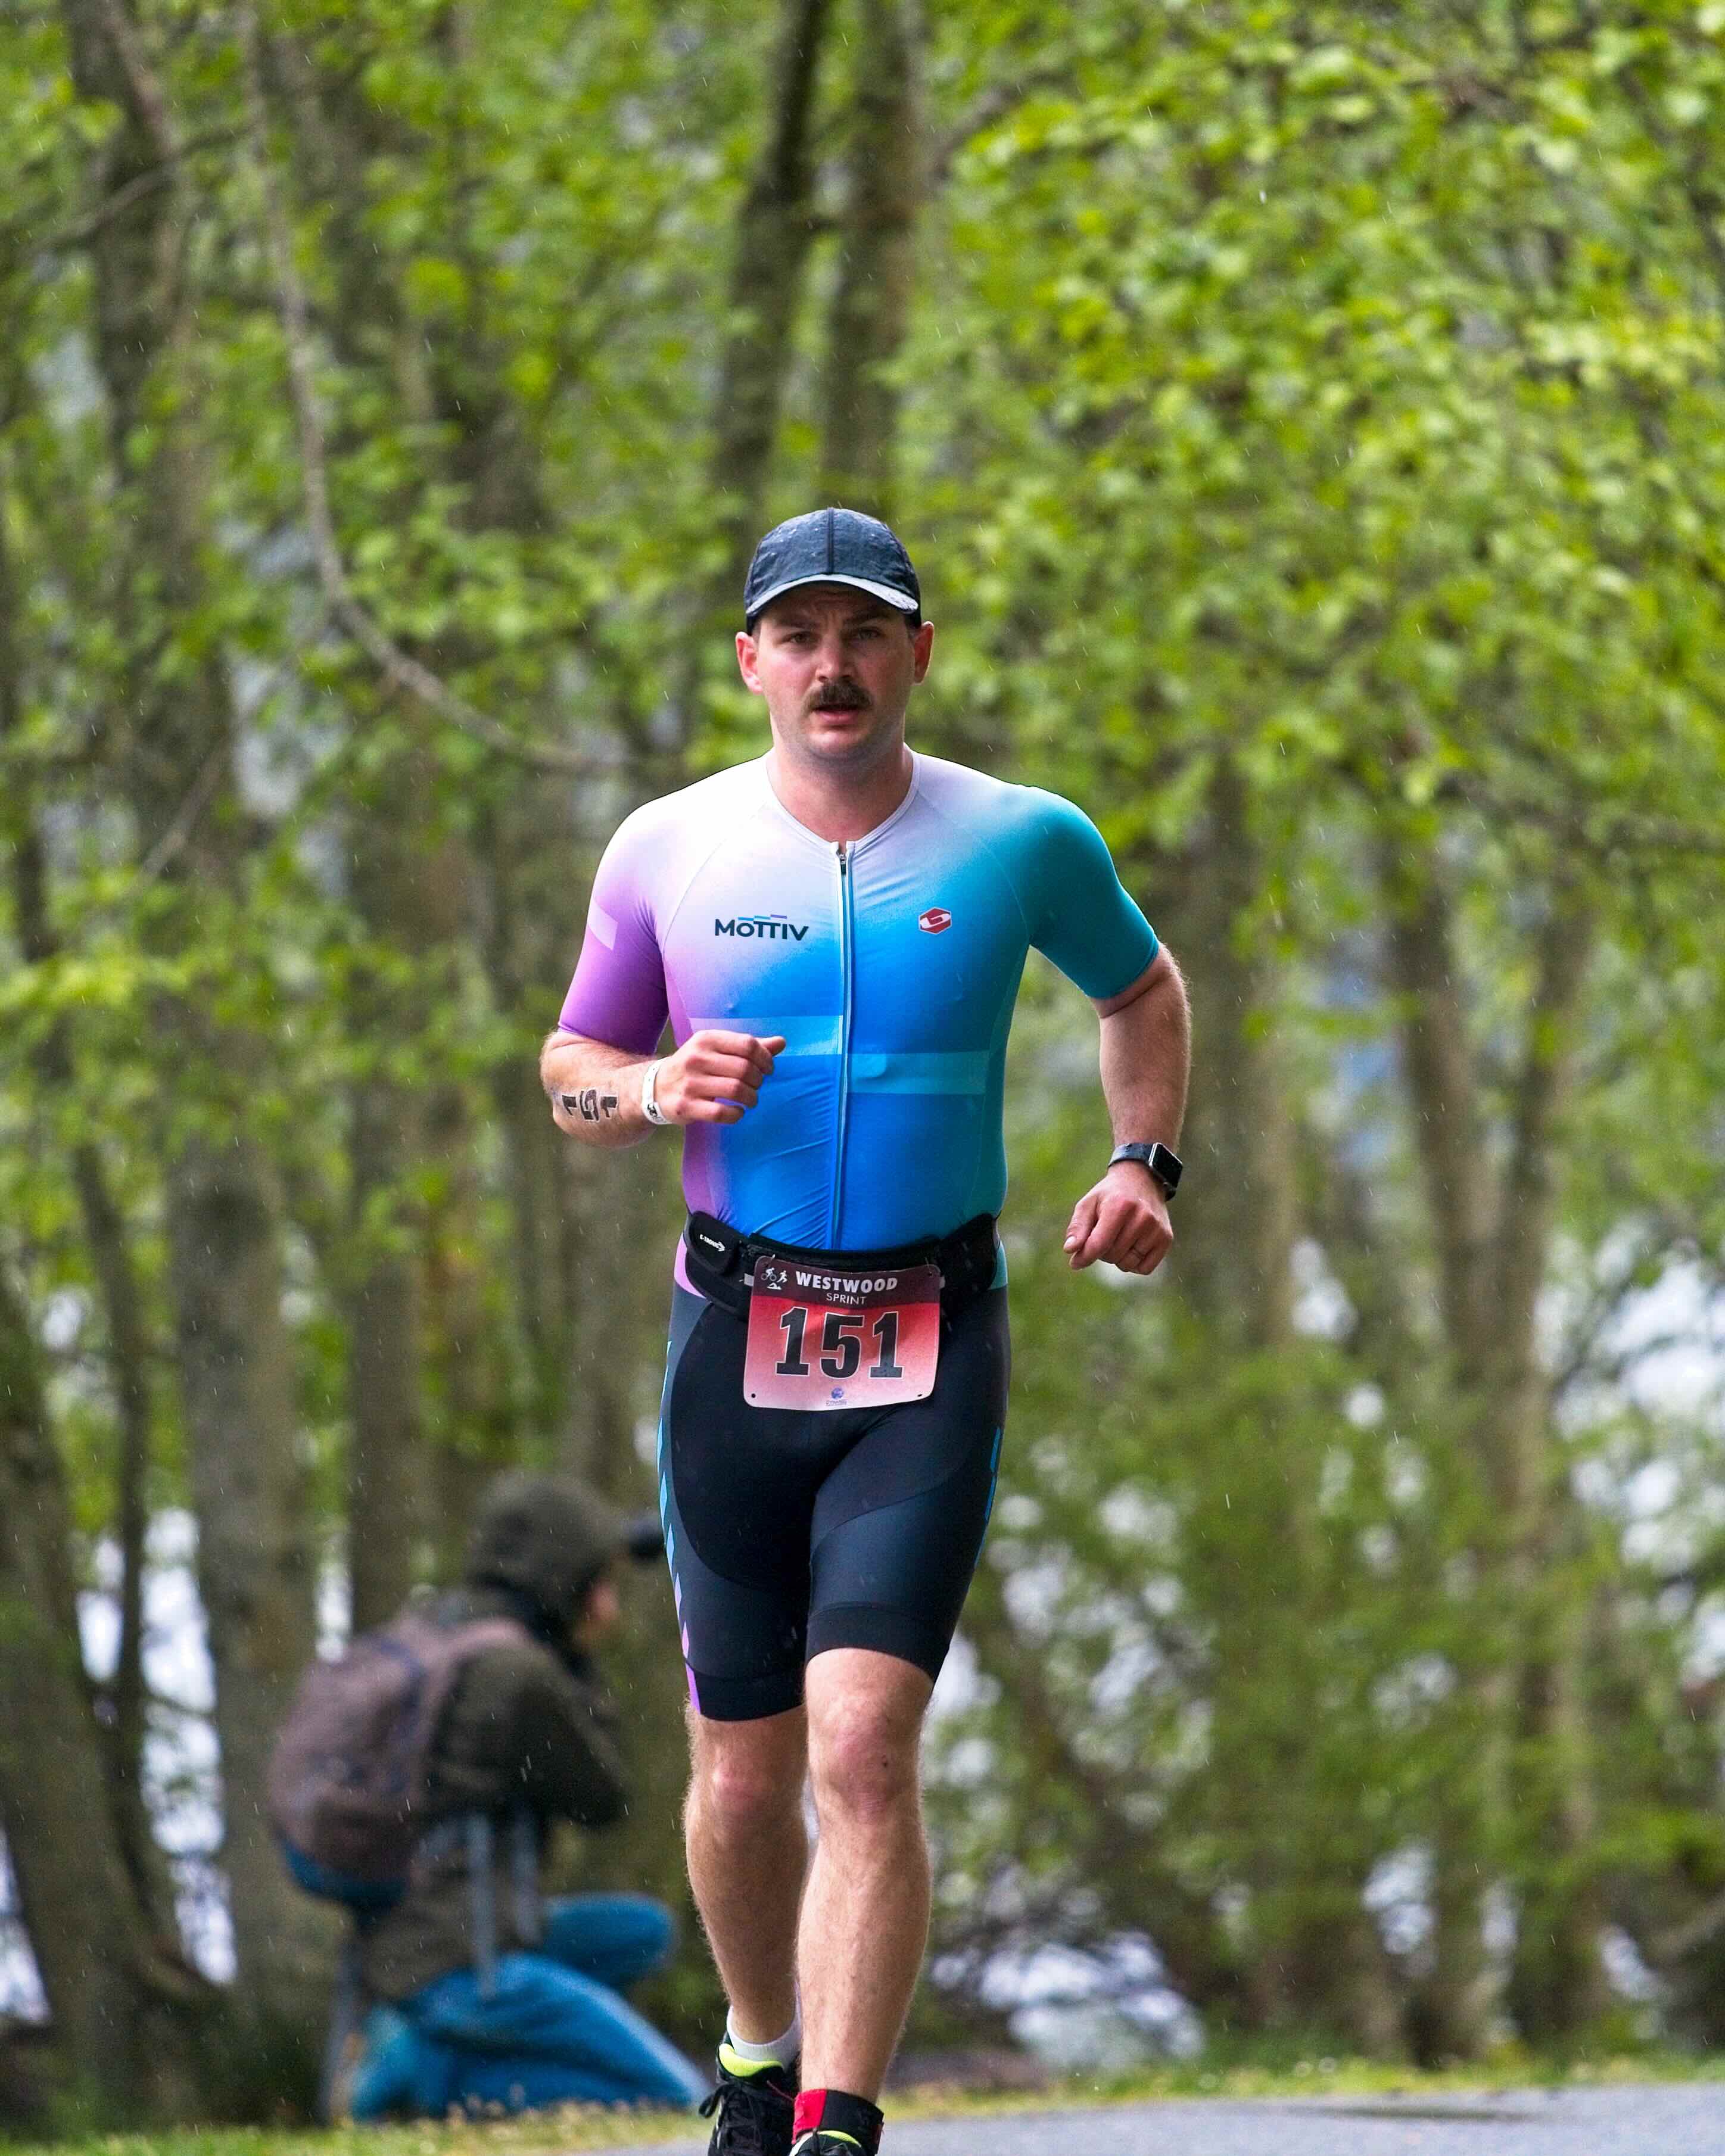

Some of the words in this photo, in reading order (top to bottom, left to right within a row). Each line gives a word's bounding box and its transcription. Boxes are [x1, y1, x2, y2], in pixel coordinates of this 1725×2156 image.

[795, 1270, 898, 1294] WESTWOOD
[826, 1292, 867, 1306] SPRINT
[775, 1306, 905, 1379] 151
